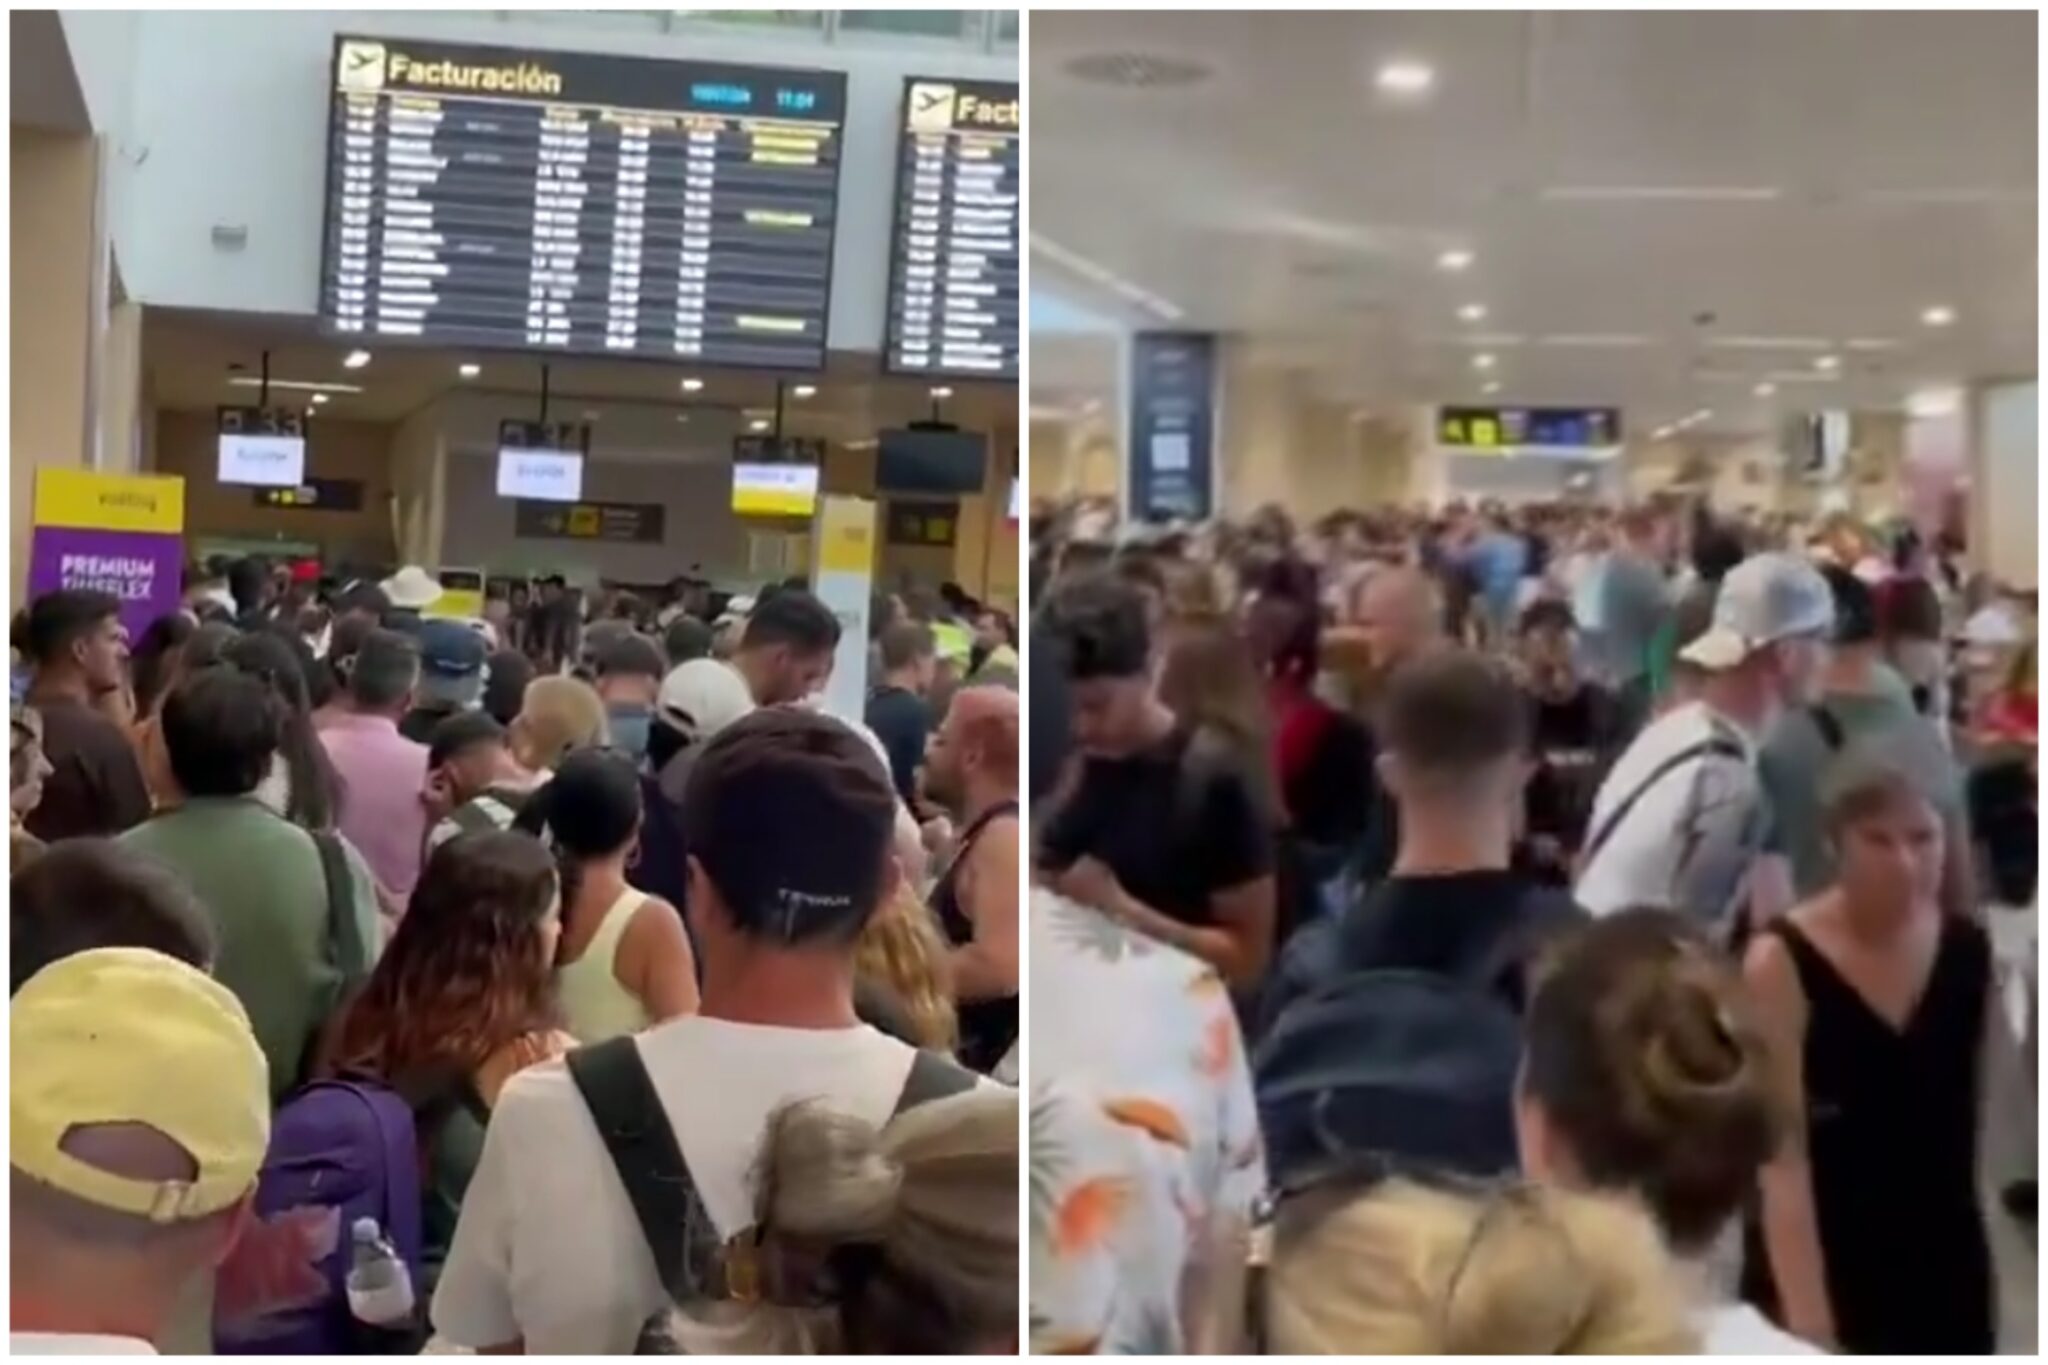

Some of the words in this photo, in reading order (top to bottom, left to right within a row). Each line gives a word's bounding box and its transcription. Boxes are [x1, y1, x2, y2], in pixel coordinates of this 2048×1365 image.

[388, 54, 562, 95] Facturación
[958, 95, 1018, 124] Fact
[61, 554, 155, 577] PREMIUM
